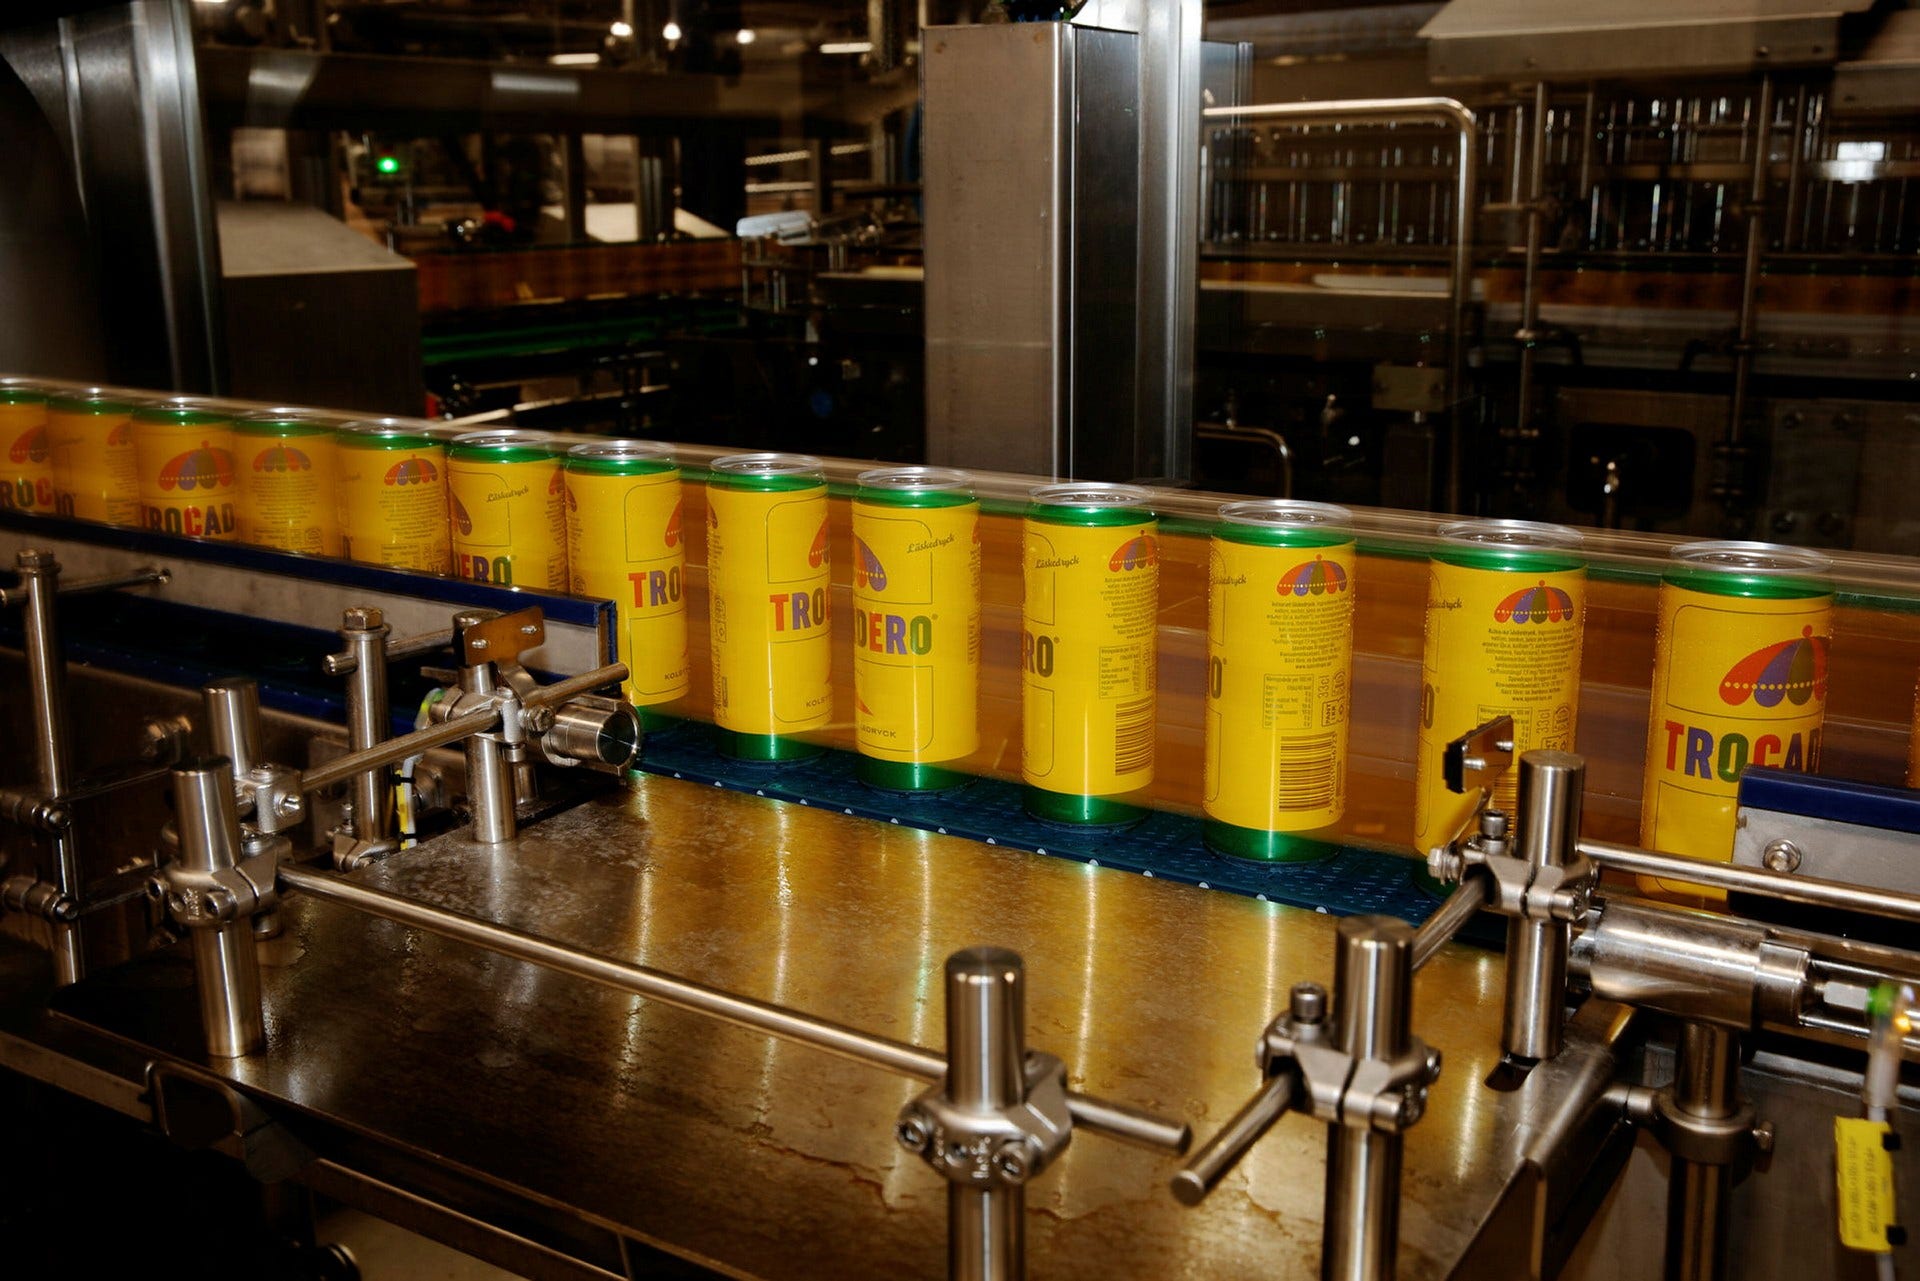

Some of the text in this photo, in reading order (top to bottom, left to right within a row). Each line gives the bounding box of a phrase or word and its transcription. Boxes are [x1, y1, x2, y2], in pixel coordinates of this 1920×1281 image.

[906, 532, 955, 553] Läskedryck
[1034, 555, 1080, 569] Läskedryck
[628, 566, 687, 608] TRO
